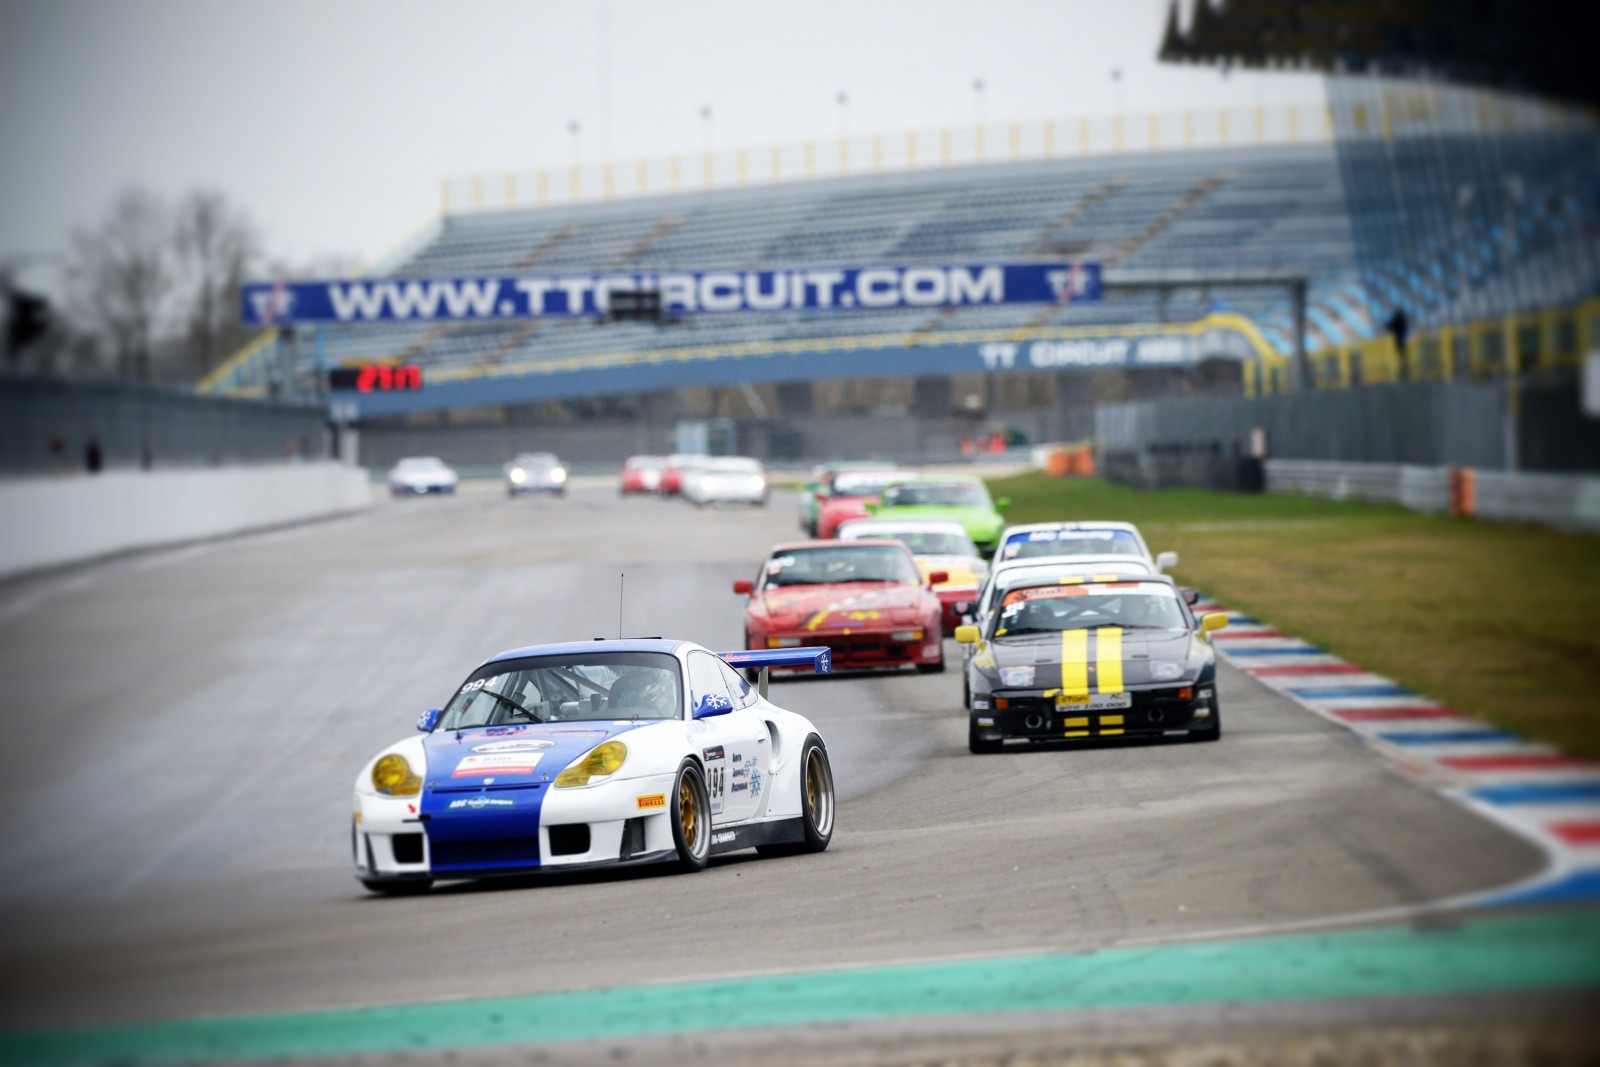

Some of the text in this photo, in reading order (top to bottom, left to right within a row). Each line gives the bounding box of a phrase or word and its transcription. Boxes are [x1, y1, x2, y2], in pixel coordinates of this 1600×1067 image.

[328, 267, 1004, 320] WWW.TTCRCUIT.COM
[460, 676, 498, 694] 994
[707, 766, 724, 798] 994
[638, 796, 665, 807] PIRELLI
